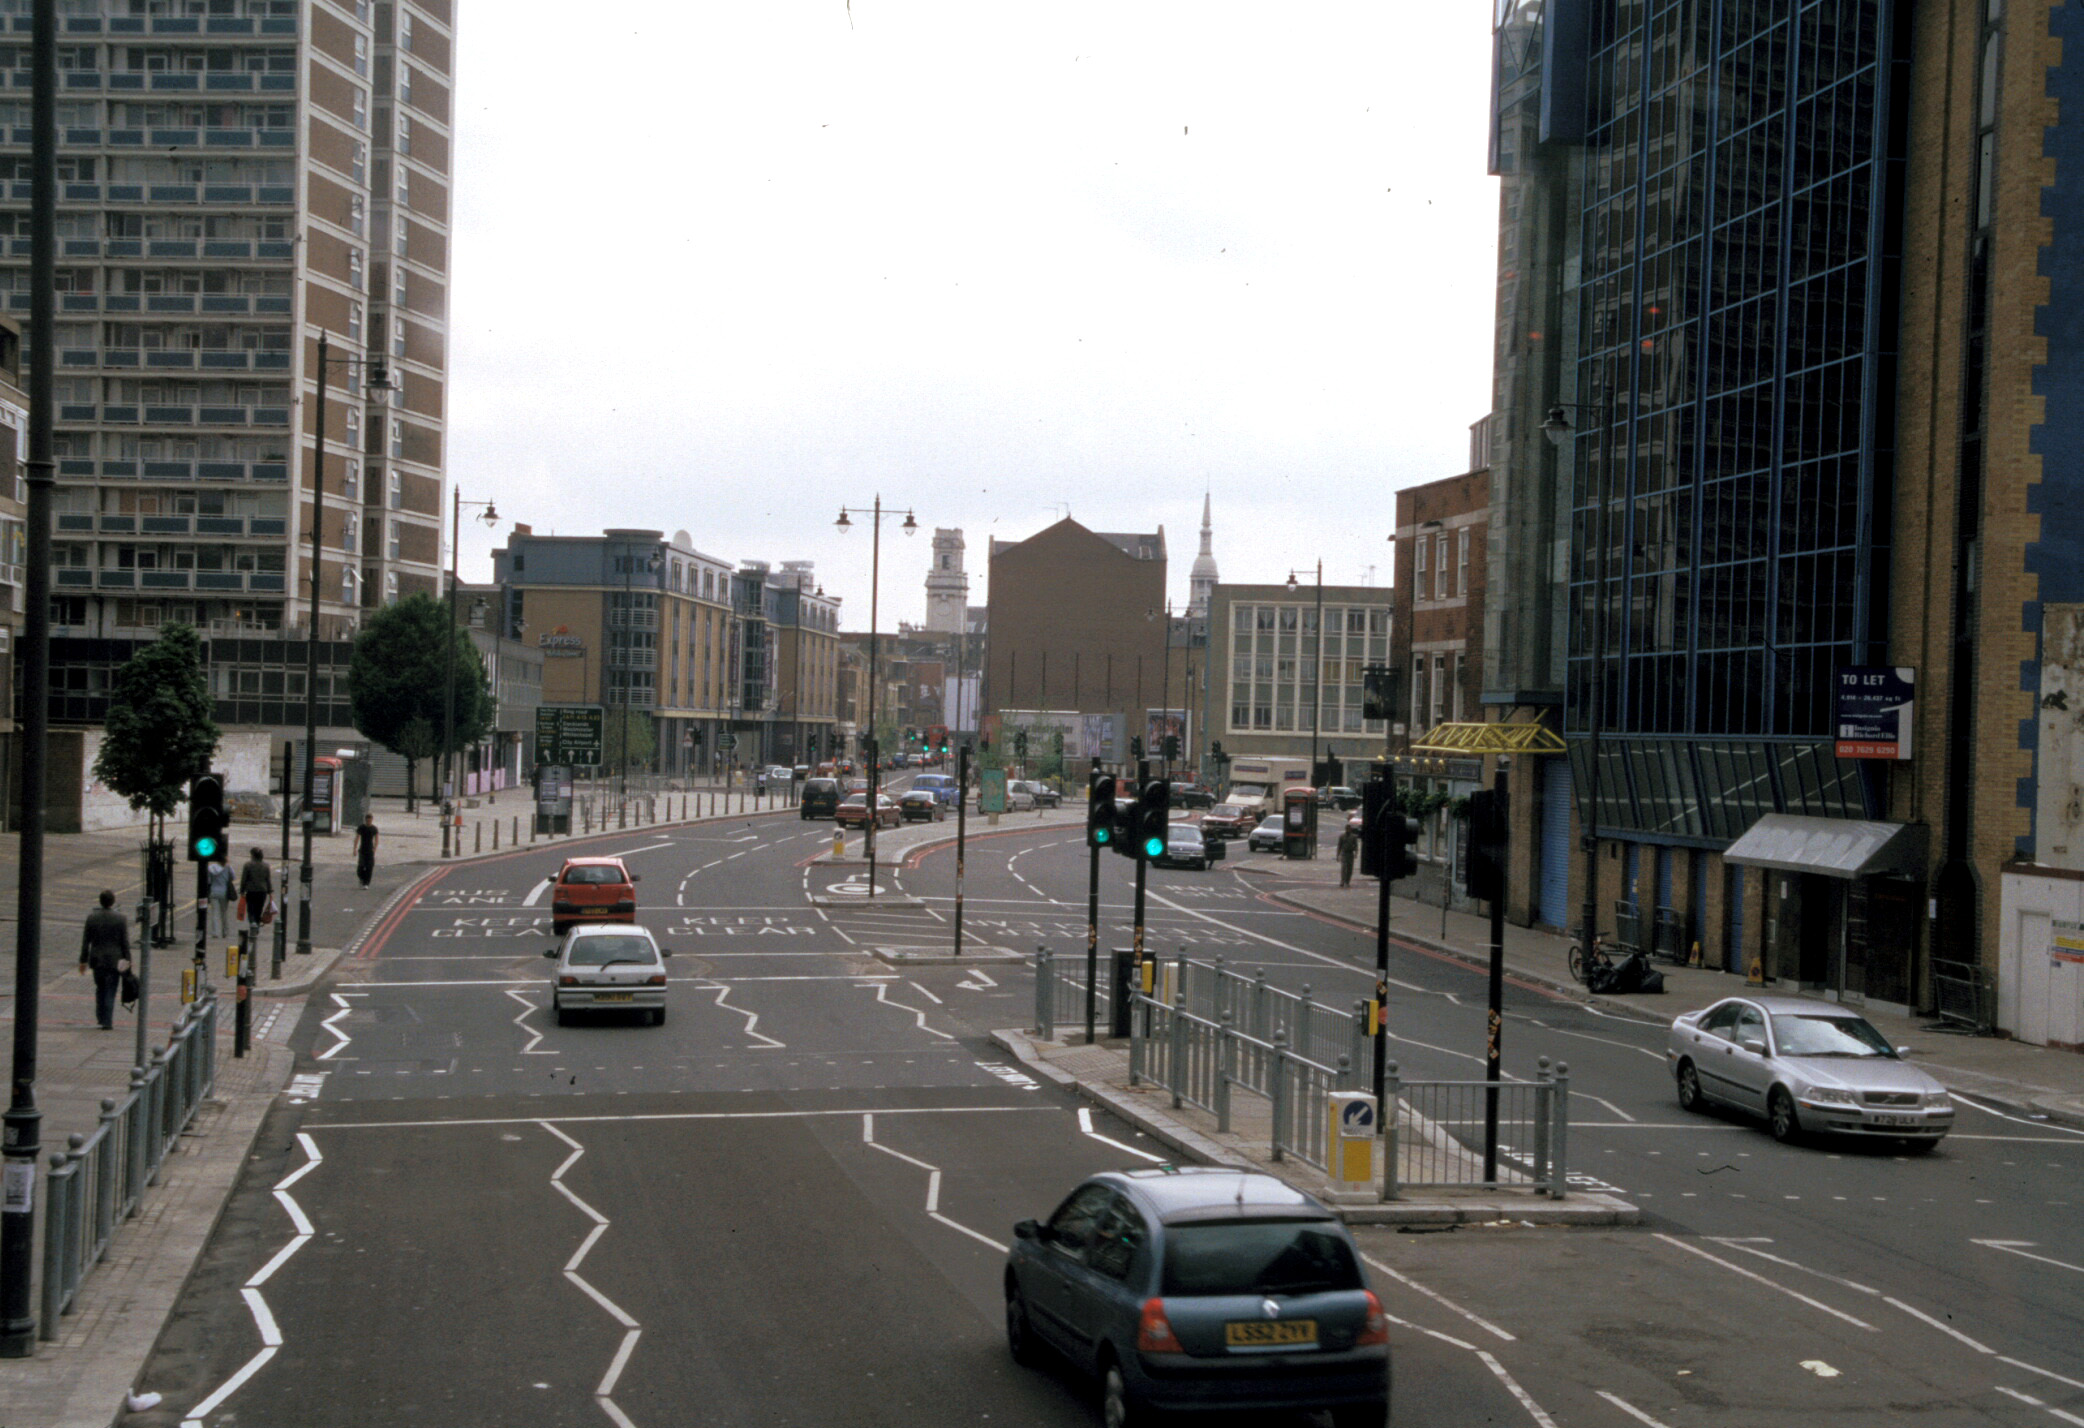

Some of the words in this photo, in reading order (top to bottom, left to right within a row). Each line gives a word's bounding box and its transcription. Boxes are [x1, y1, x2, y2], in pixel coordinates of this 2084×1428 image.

[539, 632, 582, 647] Express
[1842, 674, 1858, 685] TO
[1863, 674, 1886, 686] LET
[1839, 745, 1854, 753] 020
[453, 917, 553, 927] KEEP
[682, 917, 788, 925] KEEP
[431, 929, 554, 938] CLEA
[666, 926, 816, 935] CLEAR
